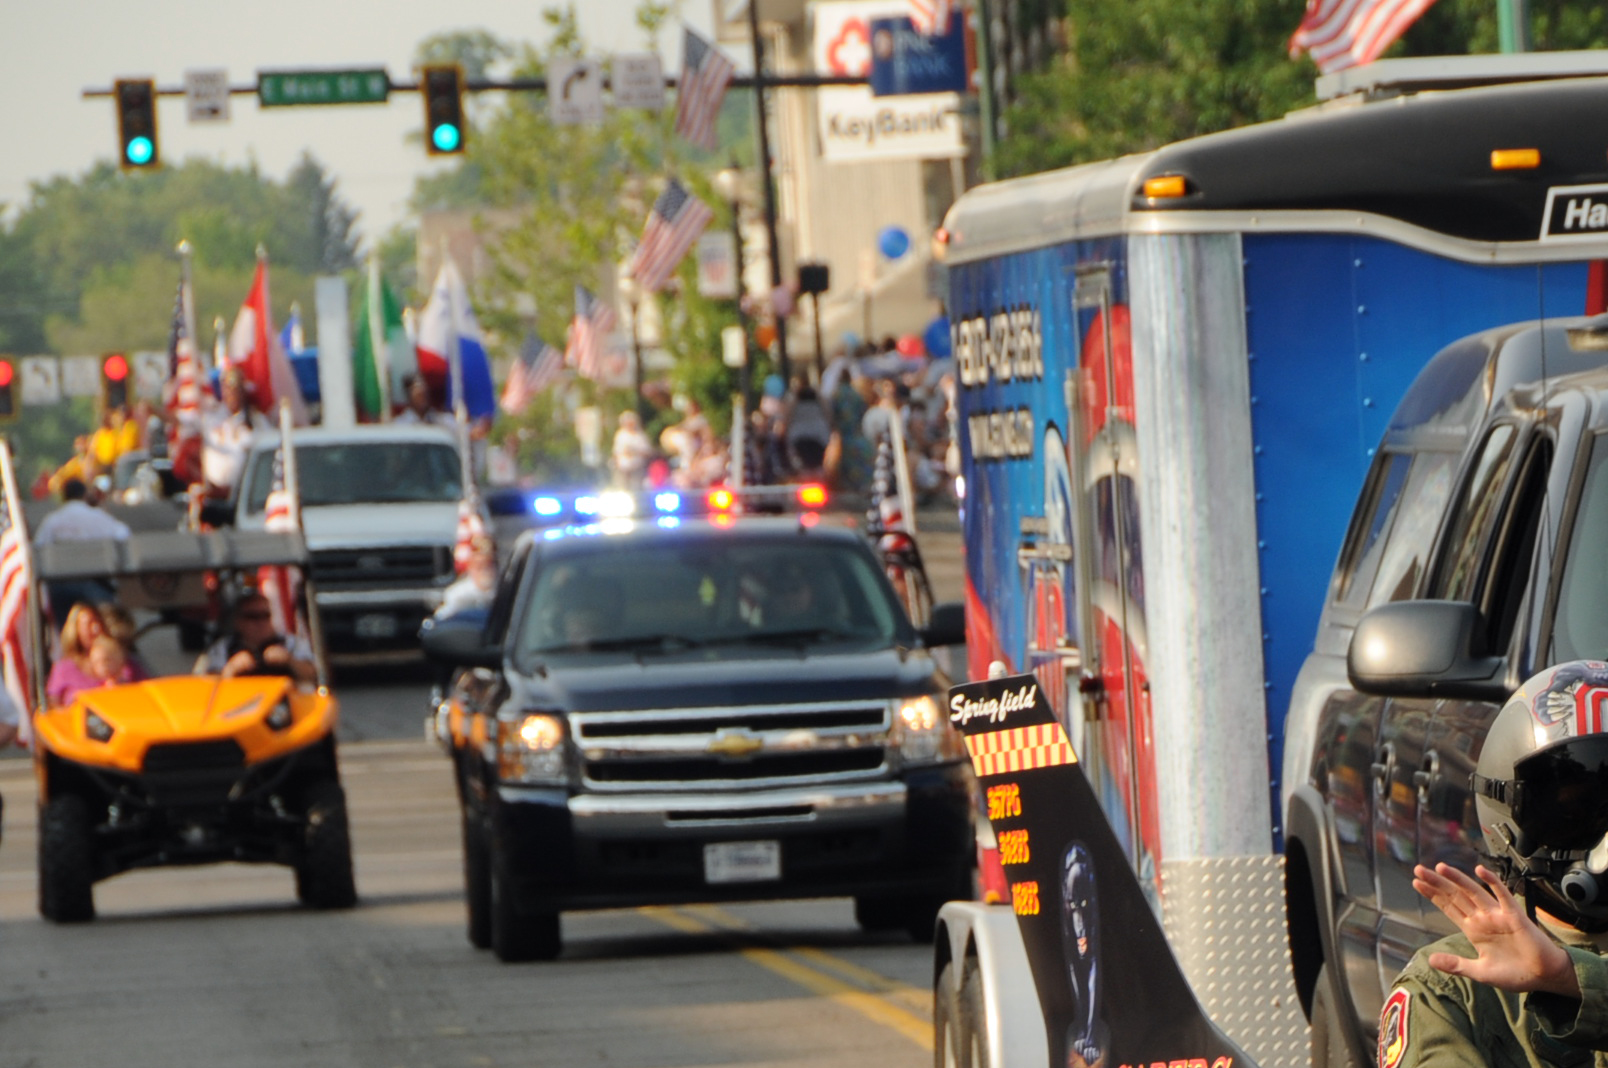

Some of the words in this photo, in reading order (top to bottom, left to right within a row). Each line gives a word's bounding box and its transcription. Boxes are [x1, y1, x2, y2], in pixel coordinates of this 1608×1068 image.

[281, 77, 330, 99] Main
[828, 108, 946, 146] KeyBank
[949, 684, 1038, 726] Springfield
